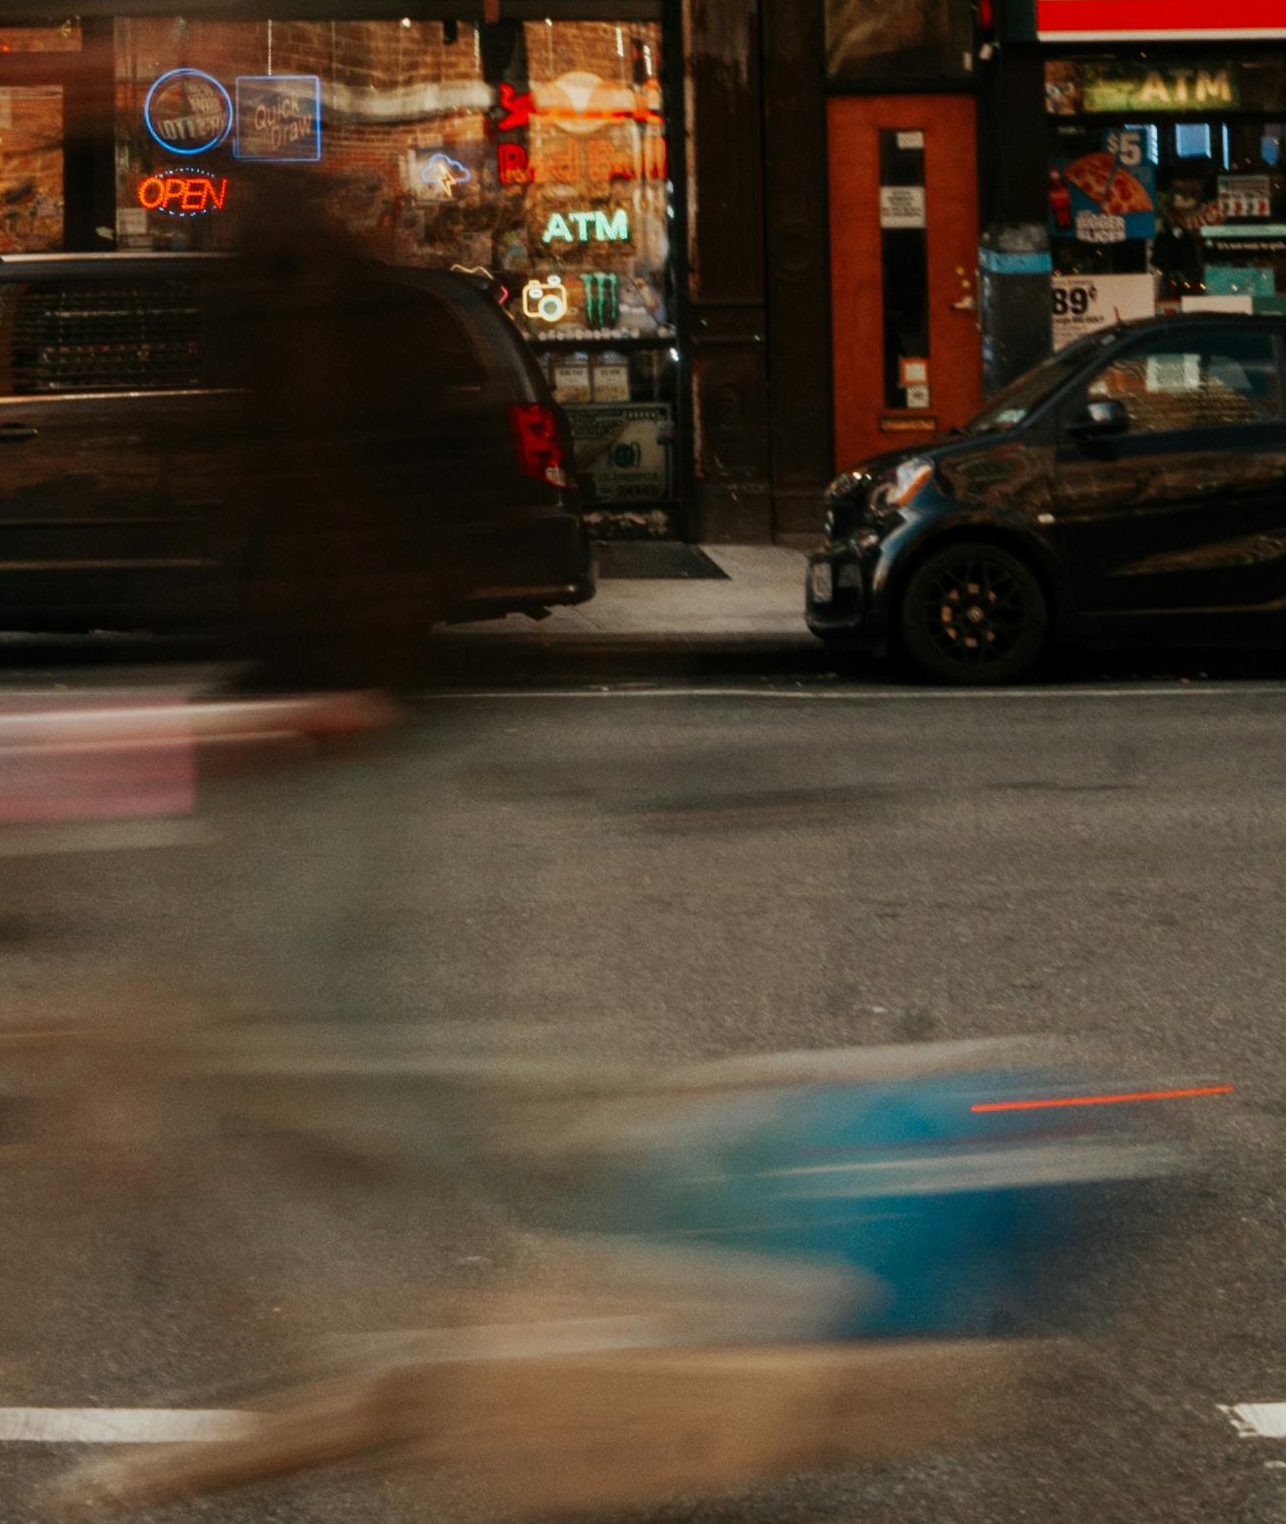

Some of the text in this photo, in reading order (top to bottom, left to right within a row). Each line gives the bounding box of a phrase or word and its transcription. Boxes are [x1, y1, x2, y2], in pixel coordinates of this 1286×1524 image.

[1139, 70, 1232, 102] ATM
[255, 92, 300, 131] Quick
[271, 114, 312, 148] Draw
[138, 177, 228, 211] OPEN
[542, 209, 629, 243] ATM
